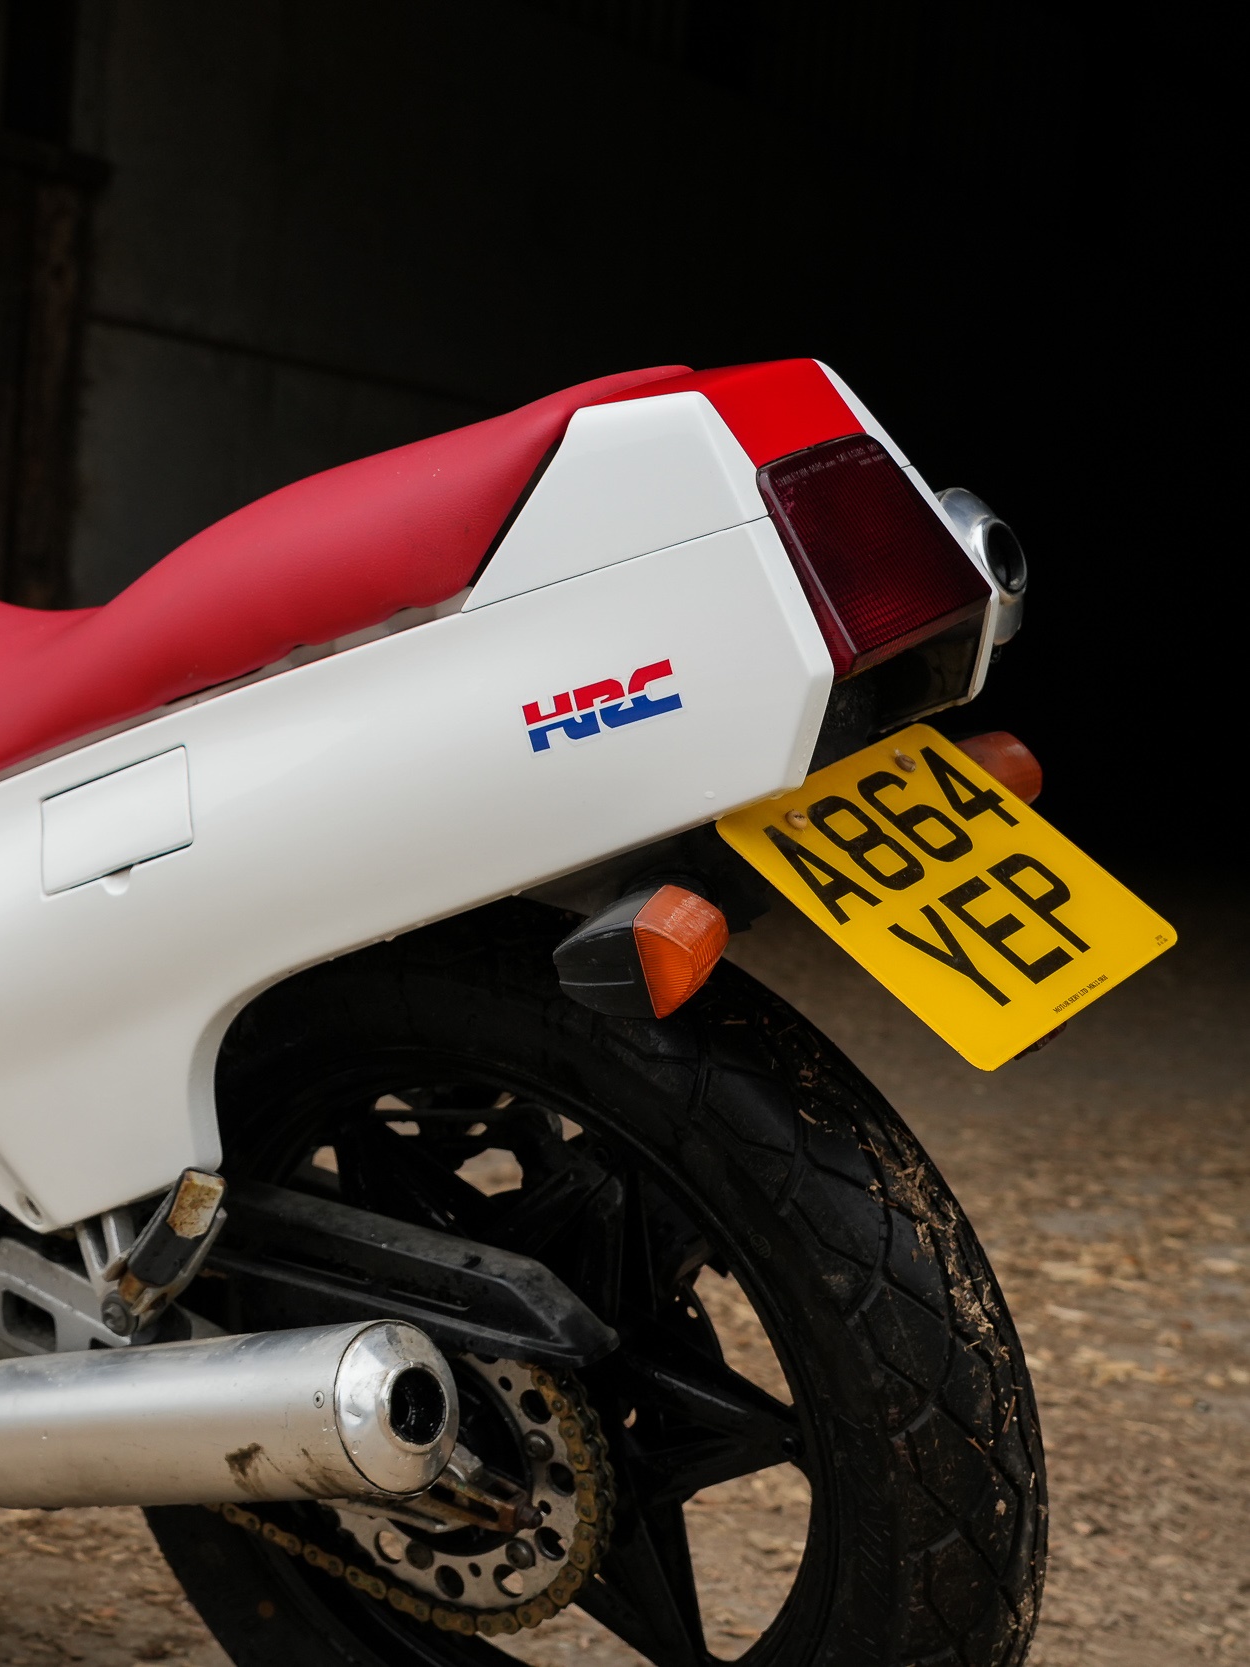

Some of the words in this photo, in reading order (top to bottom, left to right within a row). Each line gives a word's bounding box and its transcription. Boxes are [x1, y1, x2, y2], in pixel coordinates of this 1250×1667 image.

[522, 659, 682, 752] HRC
[762, 746, 1020, 926] A864
[887, 853, 1091, 1007] YEP
